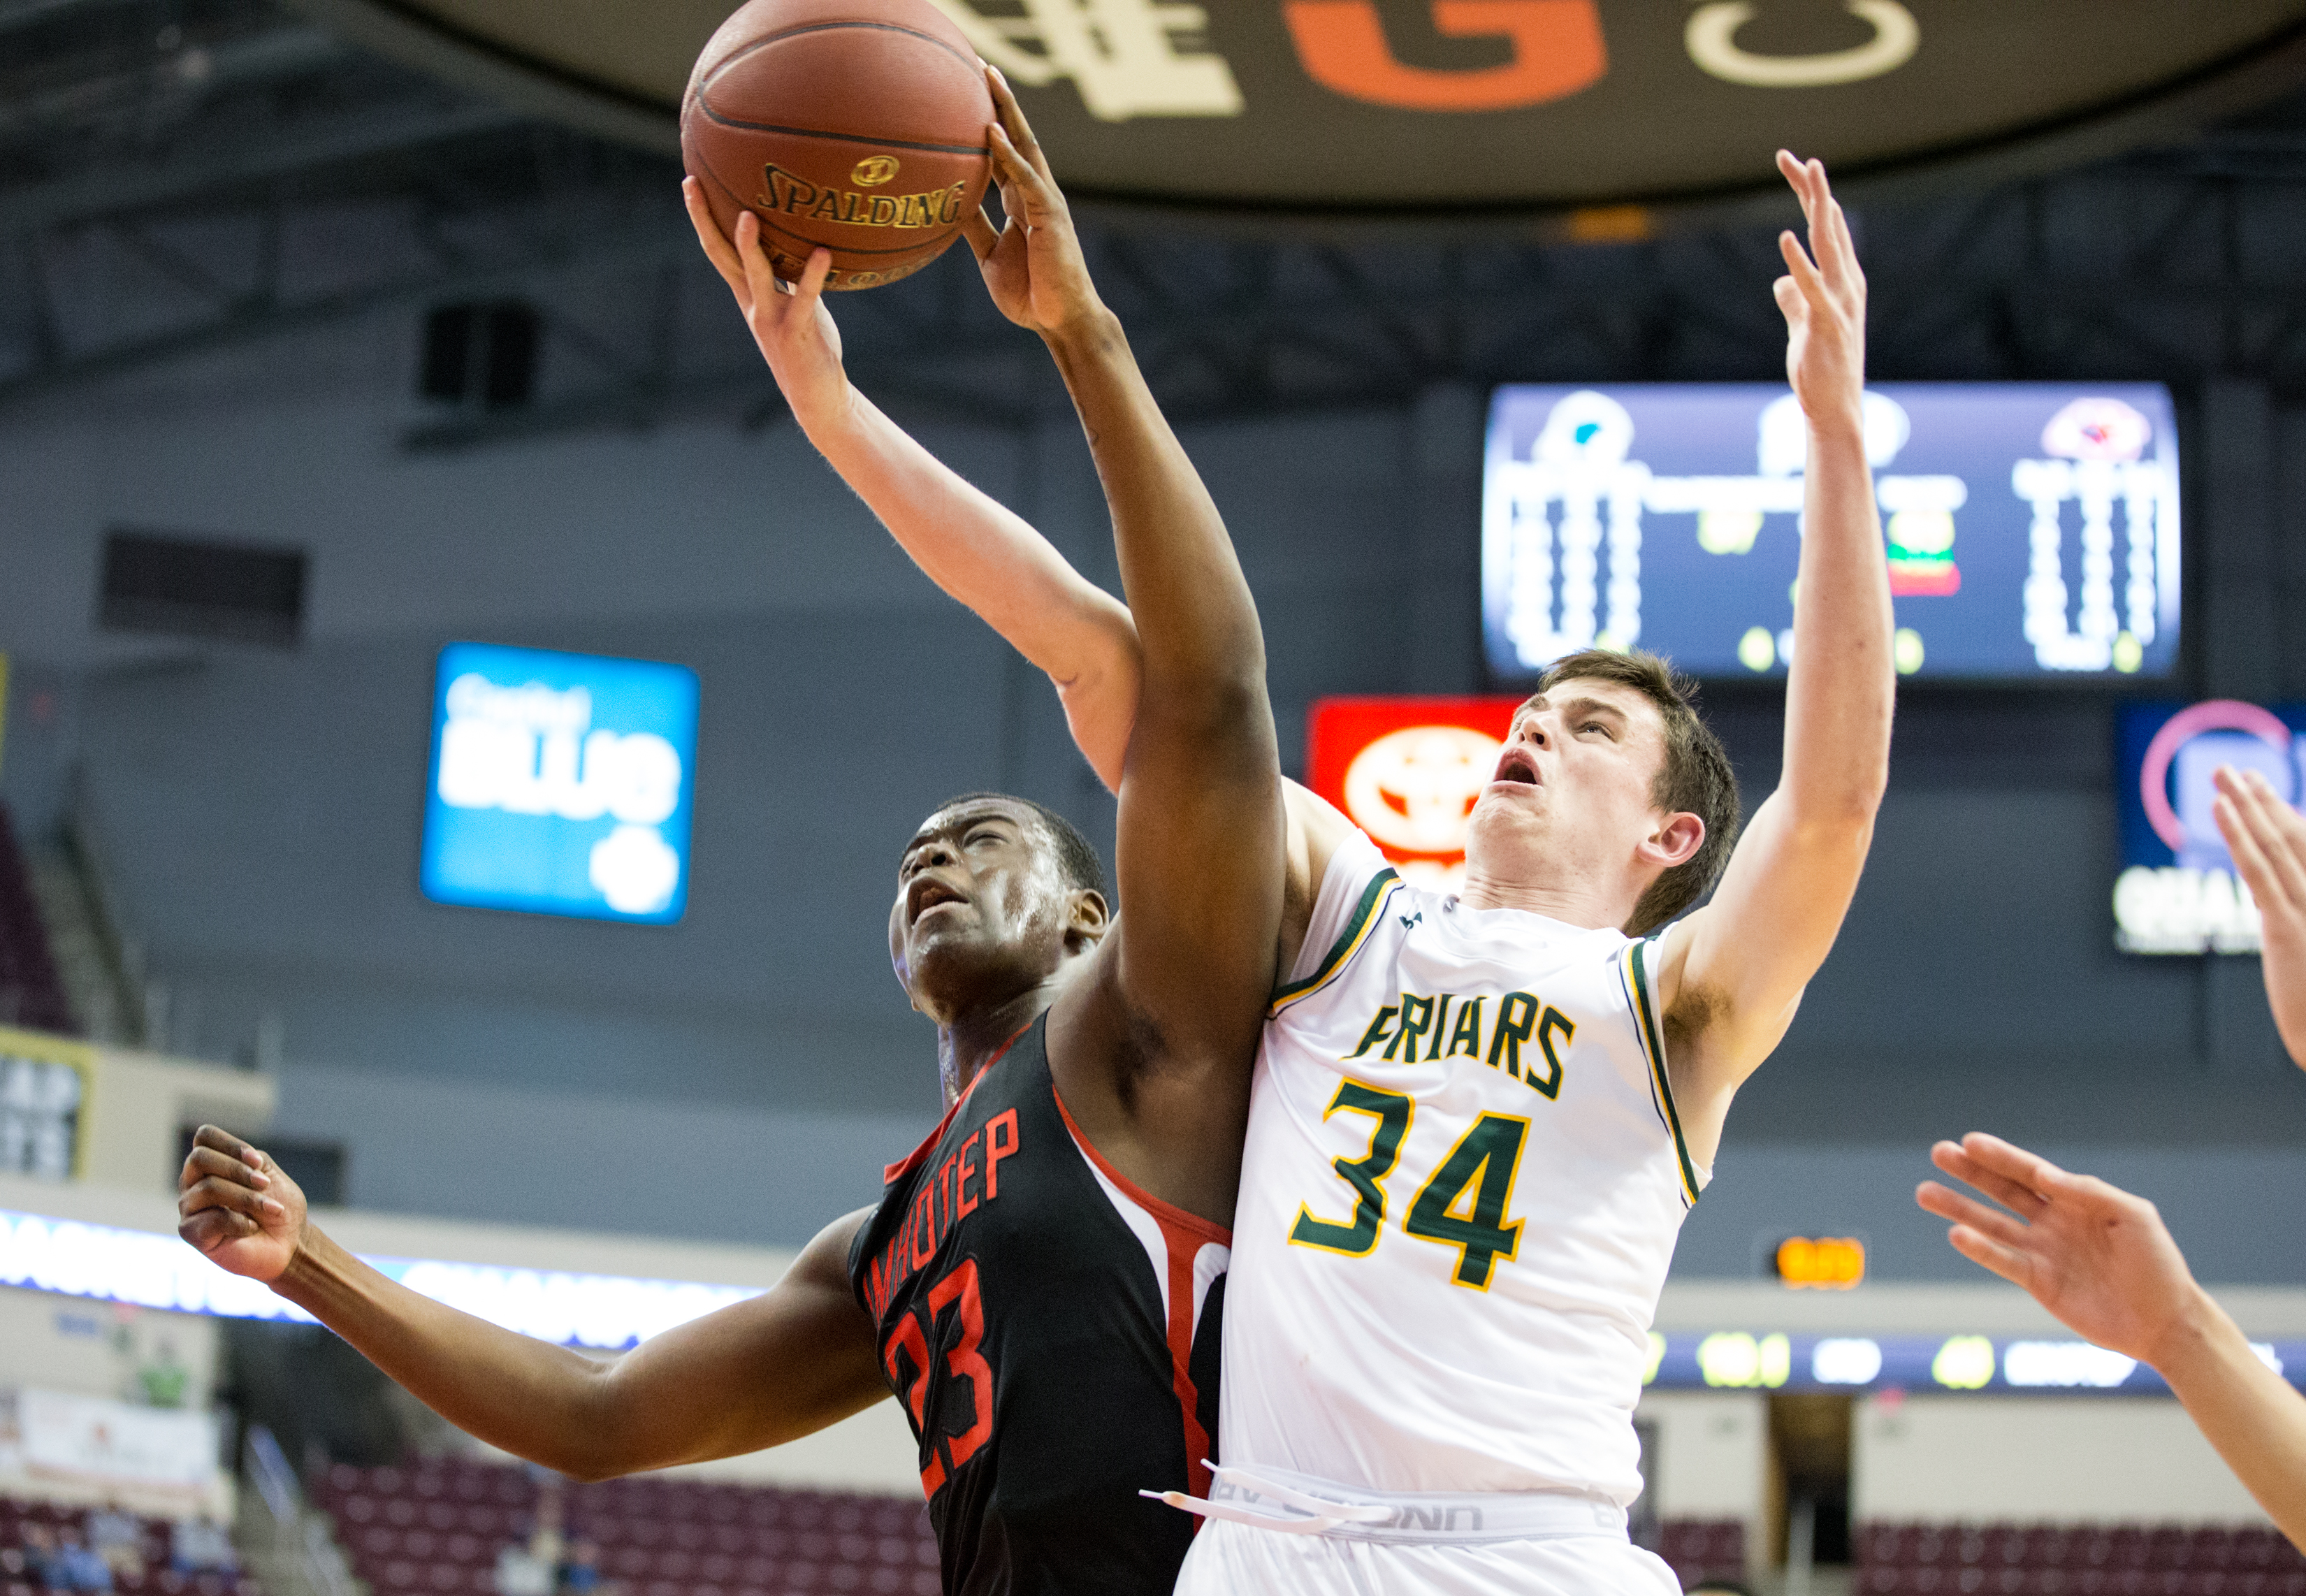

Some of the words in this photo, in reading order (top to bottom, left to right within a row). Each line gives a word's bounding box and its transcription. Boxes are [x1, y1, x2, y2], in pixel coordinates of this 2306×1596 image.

[757, 163, 966, 228] SPALDING
[1338, 991, 1576, 1102] FRIARS
[1288, 1076, 1532, 1293] 34
[884, 1258, 993, 1502] 23
